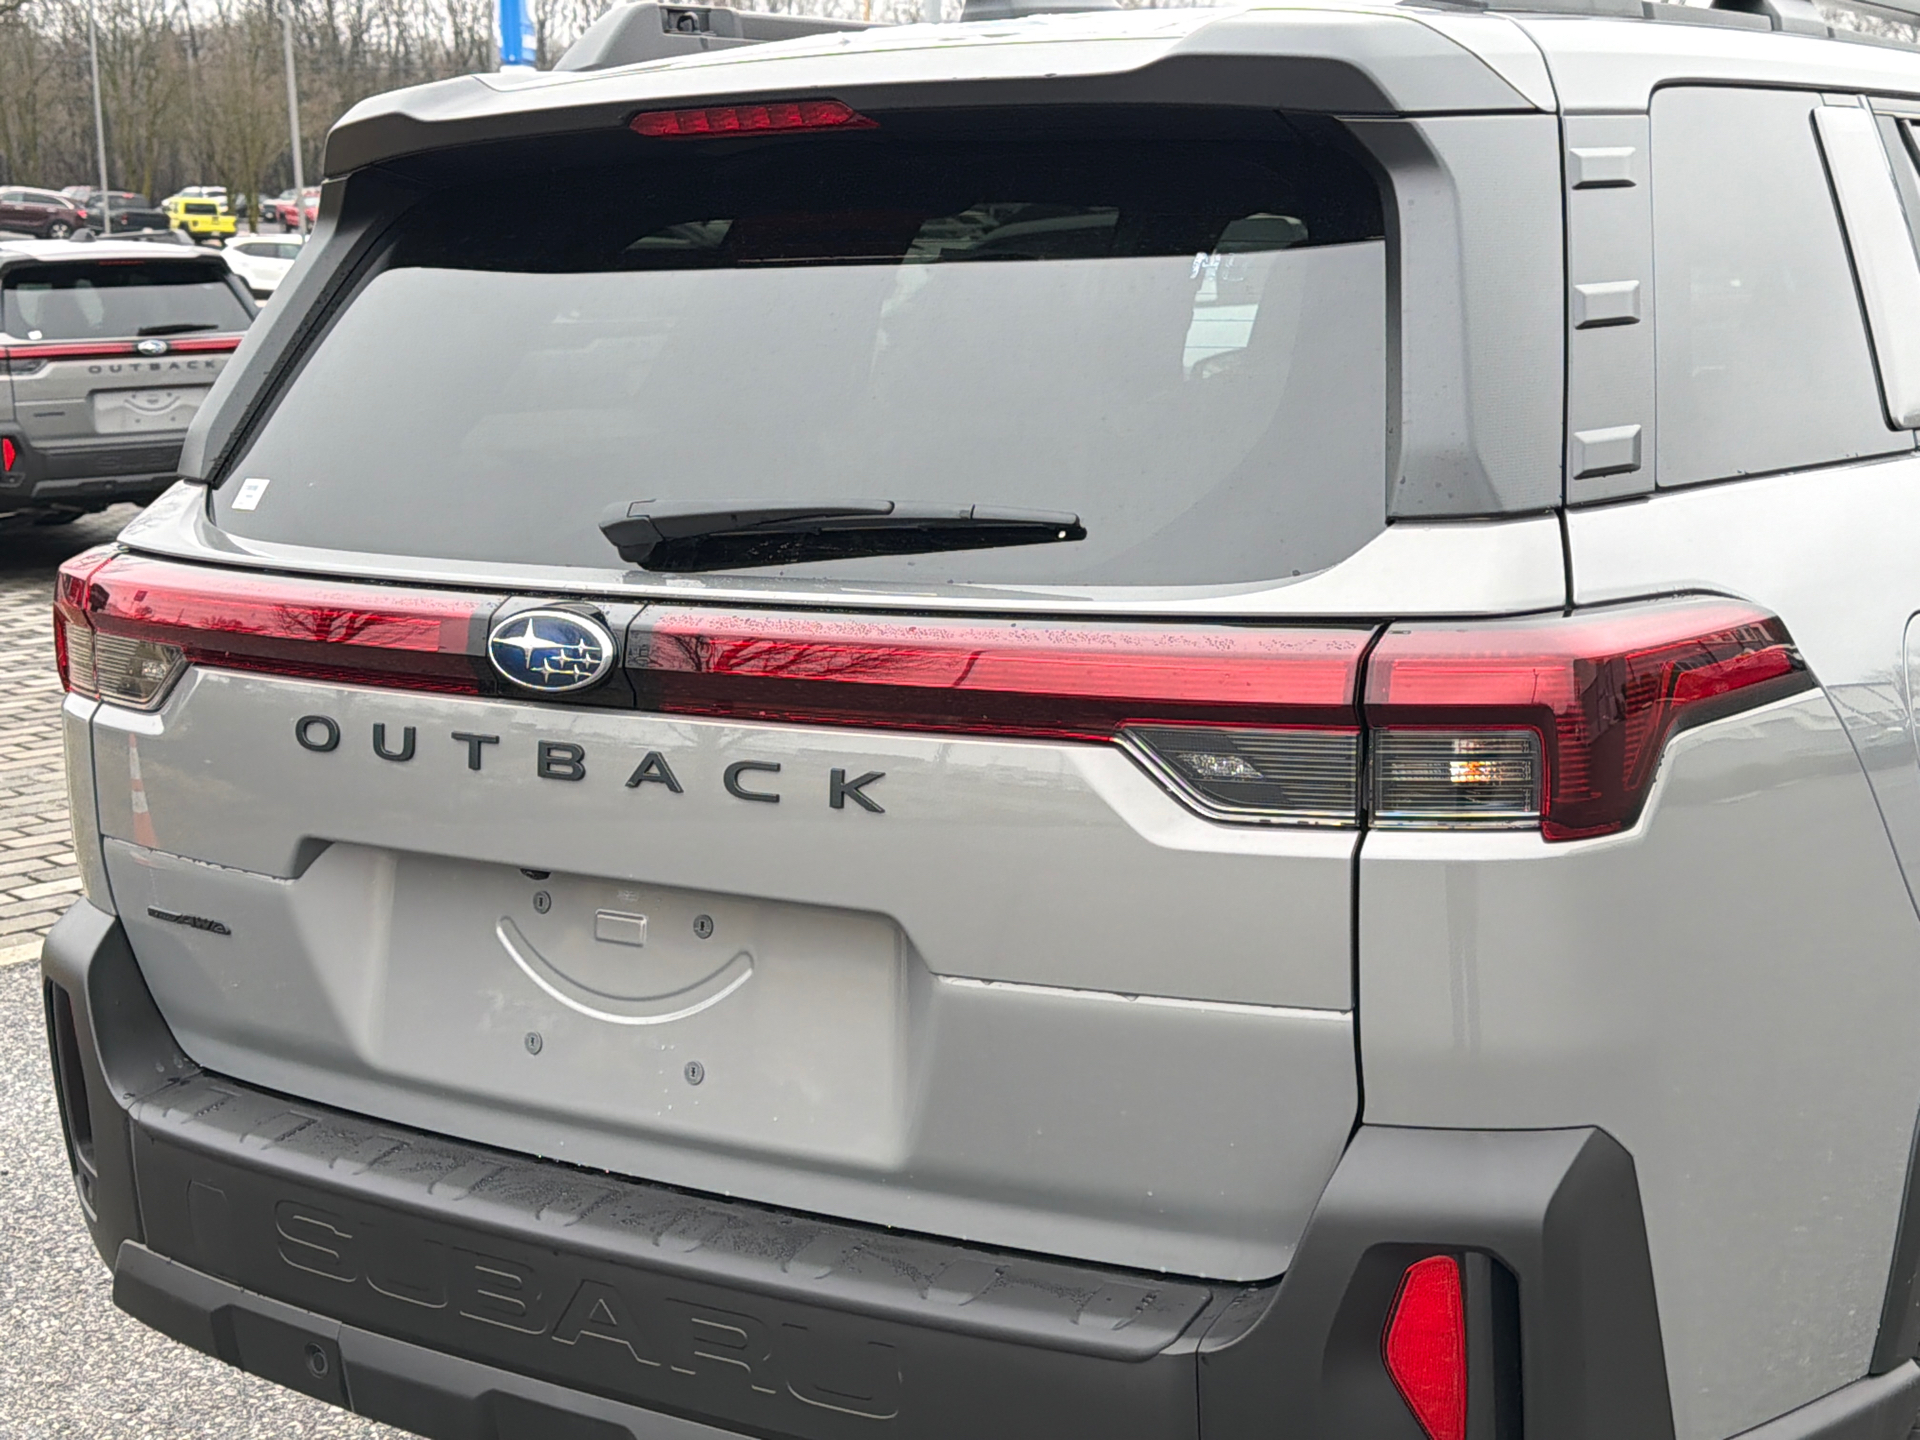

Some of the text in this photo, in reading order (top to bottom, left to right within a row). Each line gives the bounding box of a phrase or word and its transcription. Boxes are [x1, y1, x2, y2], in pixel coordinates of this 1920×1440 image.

[88, 360, 215, 374] OUTBACK
[295, 714, 887, 814] OUTBACK
[275, 1200, 903, 1420] SUBARU
